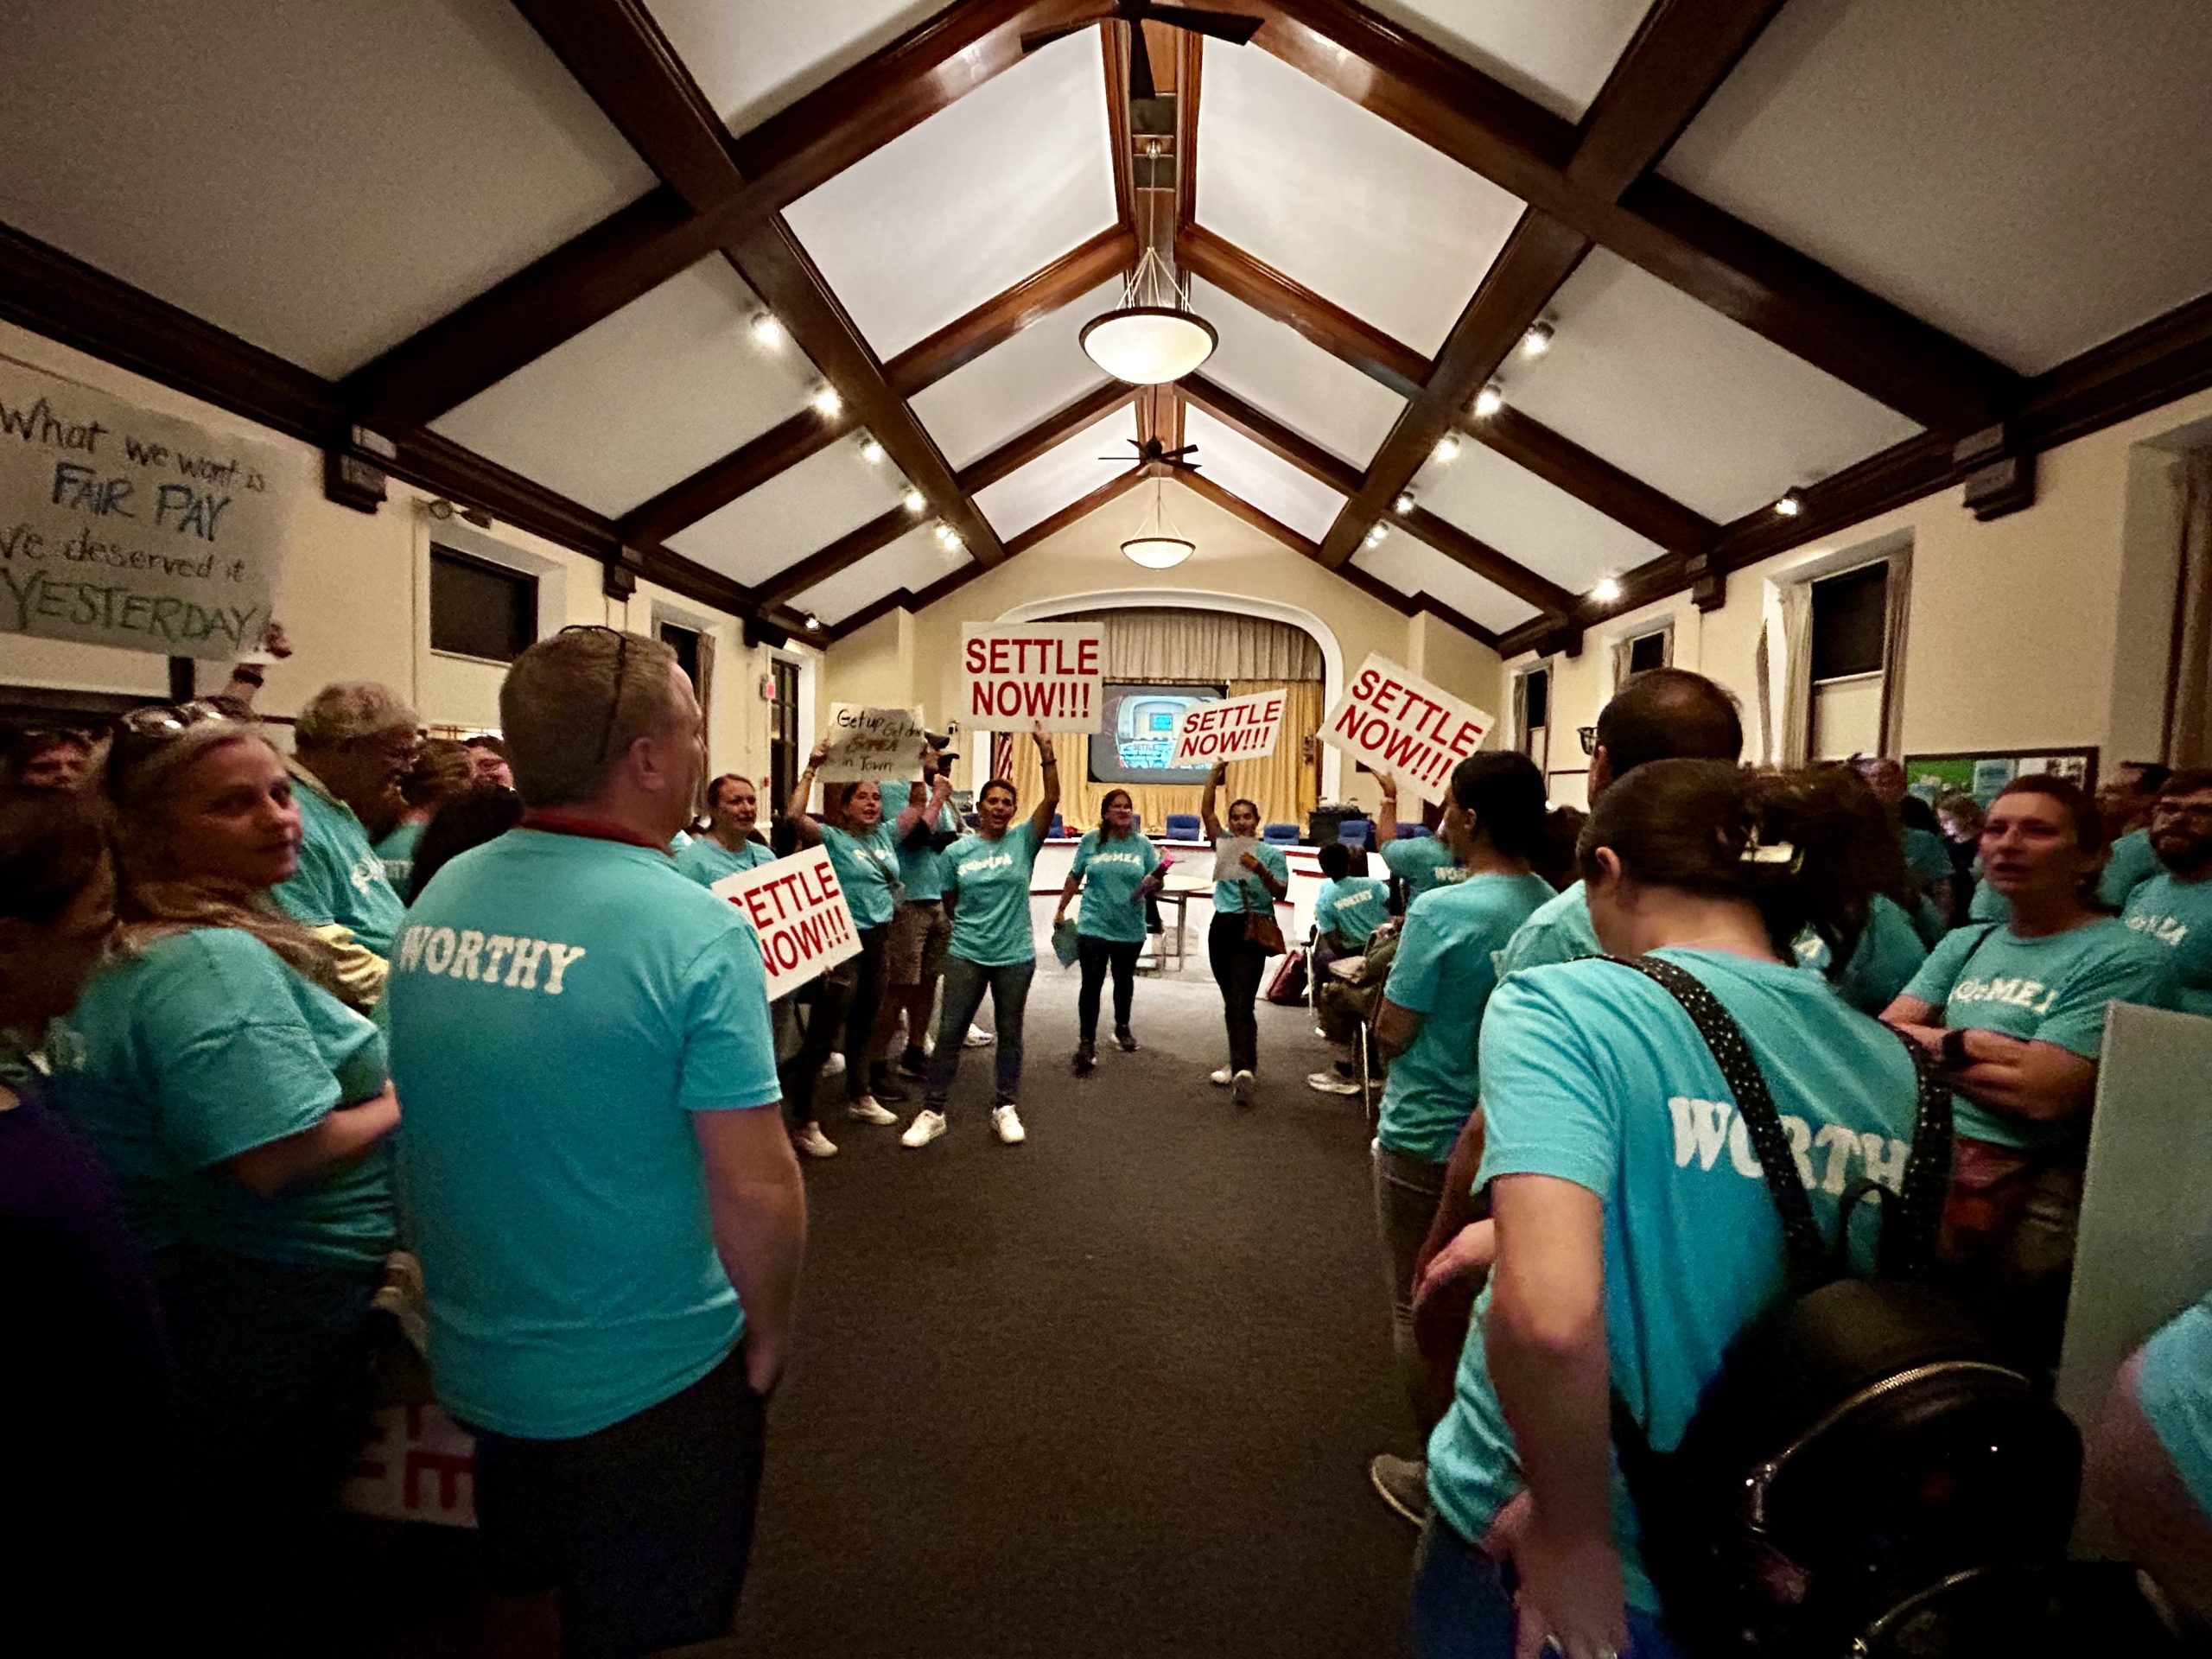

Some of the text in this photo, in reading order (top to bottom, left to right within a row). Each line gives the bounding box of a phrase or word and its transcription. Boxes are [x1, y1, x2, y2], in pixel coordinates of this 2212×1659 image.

[0, 397, 109, 454] What
[126, 435, 170, 467] we
[178, 453, 242, 487] want
[53, 461, 232, 542] FAIR PAY
[65, 526, 214, 580] deserved
[226, 558, 245, 583] it
[0, 567, 257, 651] YESTERDAY
[966, 638, 1099, 676] SETTLE
[836, 709, 885, 734] Get up
[972, 680, 1090, 719] NOW!!!
[1183, 700, 1282, 734] SETTLE
[1351, 669, 1484, 759] SETTLE
[1180, 727, 1270, 758] NOW!!!
[1335, 703, 1454, 788] NOW!!!
[728, 861, 840, 930] ETTLE
[397, 925, 587, 995] WORTHY
[1668, 1096, 1914, 1205] WORTH
